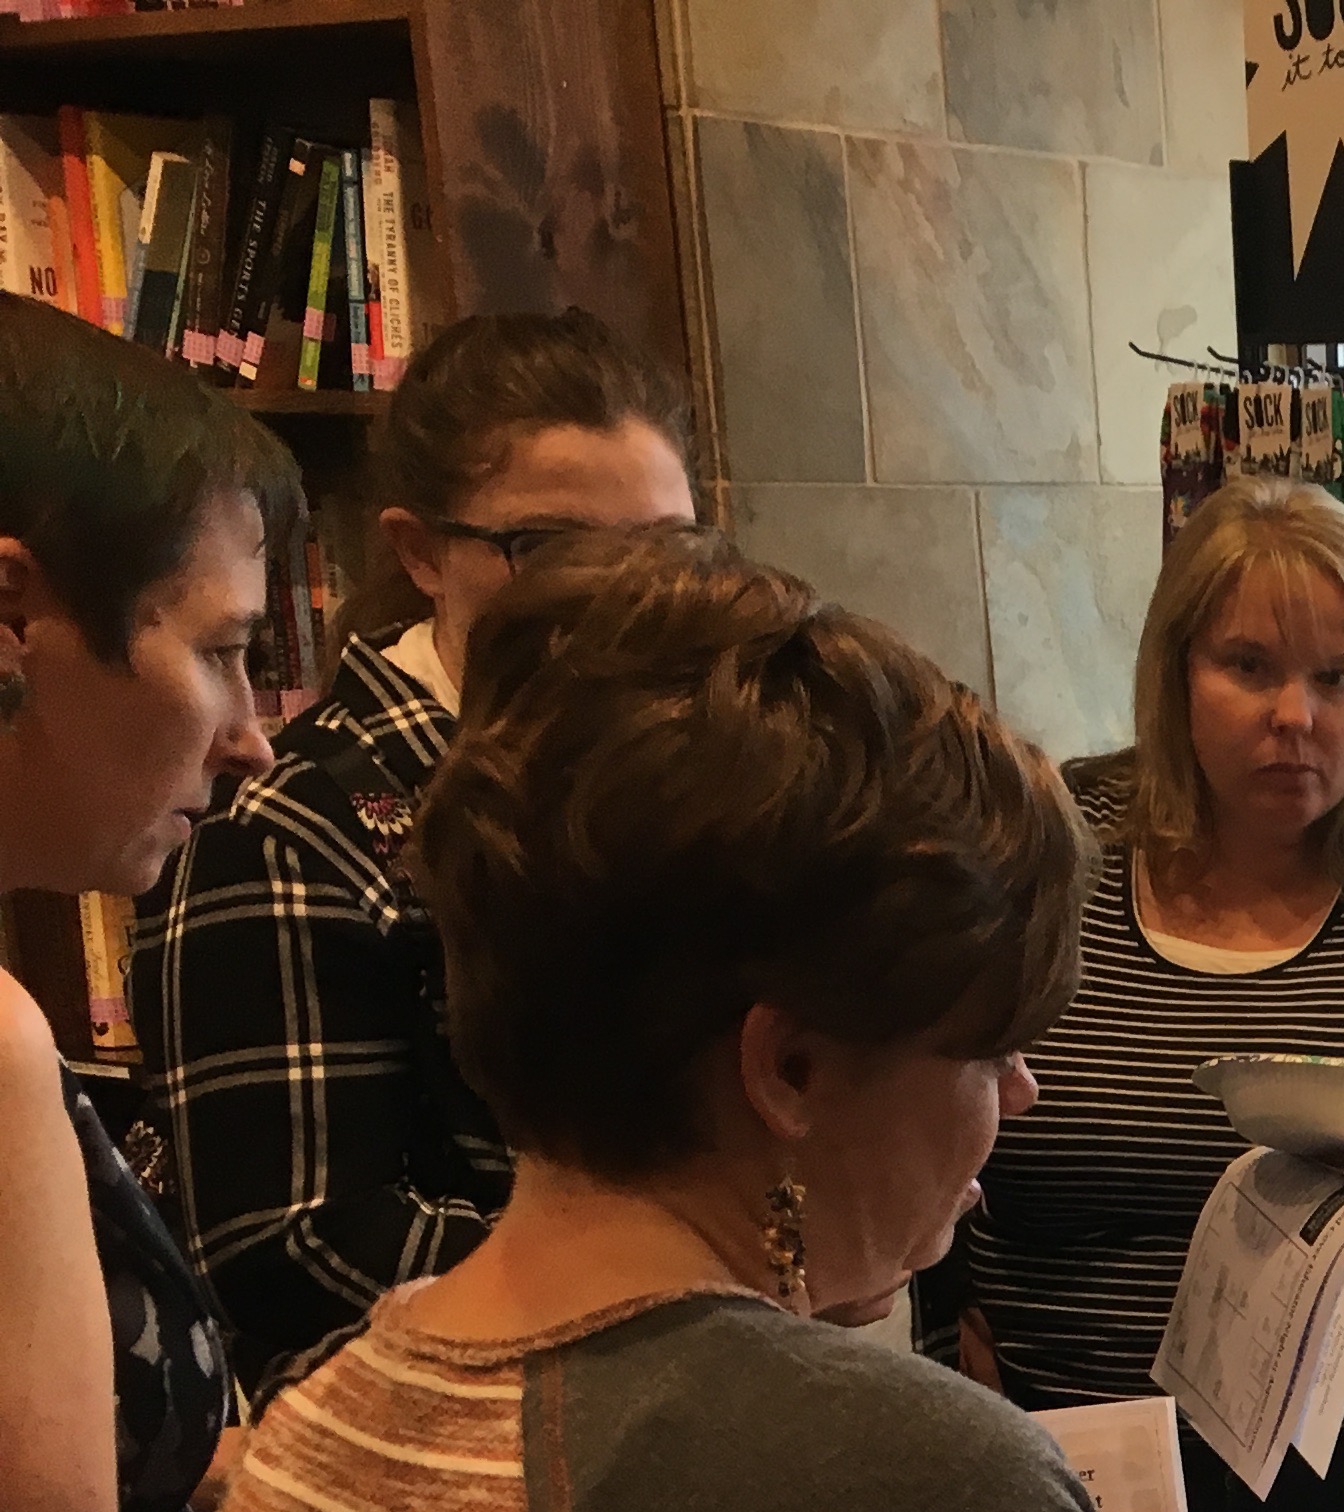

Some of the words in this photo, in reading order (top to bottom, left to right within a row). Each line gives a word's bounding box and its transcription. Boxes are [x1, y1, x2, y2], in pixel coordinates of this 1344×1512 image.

[1281, 53, 1312, 92] it
[253, 200, 266, 234] THE
[383, 191, 394, 214] THE
[385, 218, 398, 274] TYRANNY
[237, 239, 258, 301] SPORTS
[387, 277, 399, 294] OF
[1174, 391, 1200, 427] SOCK
[1244, 391, 1284, 430] SOCK
[1305, 397, 1328, 436] SOCK
